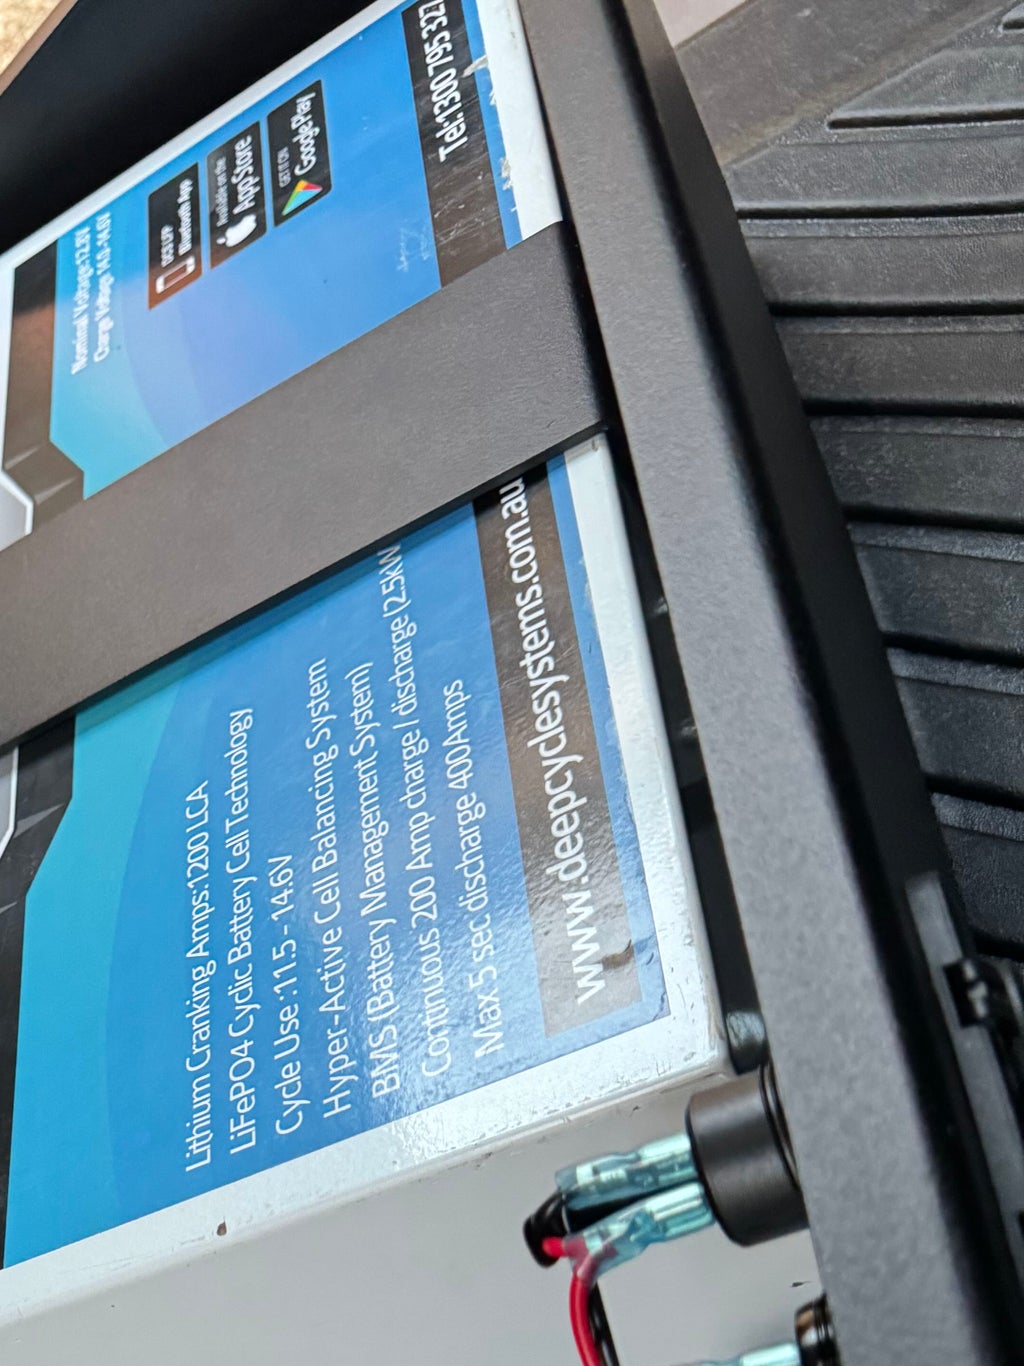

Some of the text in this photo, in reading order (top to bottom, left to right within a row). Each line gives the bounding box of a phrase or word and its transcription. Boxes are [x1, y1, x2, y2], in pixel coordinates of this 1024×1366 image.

[417, 0, 468, 162] Tel:1300 795 327
[277, 146, 289, 164] ON
[290, 92, 320, 175] Google Play
[215, 156, 228, 227] Available on the
[231, 135, 260, 215] App Store
[278, 171, 291, 188] GET
[178, 178, 193, 256] Bluetooth App
[71, 313, 89, 375] Nominal
[93, 316, 114, 362] Charge
[388, 614, 418, 716] discharge
[392, 719, 420, 730] /
[499, 476, 605, 1004] www.deepcyclesystems.com.au
[185, 780, 209, 833] LCA
[399, 728, 429, 809] charge
[344, 662, 401, 1098] BMS (Battery Management System)
[405, 811, 436, 871] Amp
[442, 679, 505, 1058] Max 5 sec discharge 400Amps
[268, 855, 294, 921] 14.6V
[305, 658, 359, 1118] Hyper-Active Cell Balancing System
[408, 875, 438, 929] 200
[224, 708, 260, 1155] LiFePO4 Cyclic Battery Cell Technology
[185, 959, 217, 1072] Cranking
[273, 1003, 300, 1060] Use
[419, 927, 452, 1078] Continuous
[185, 1073, 214, 1172] Lithium
[274, 1060, 311, 1135] Cycle
